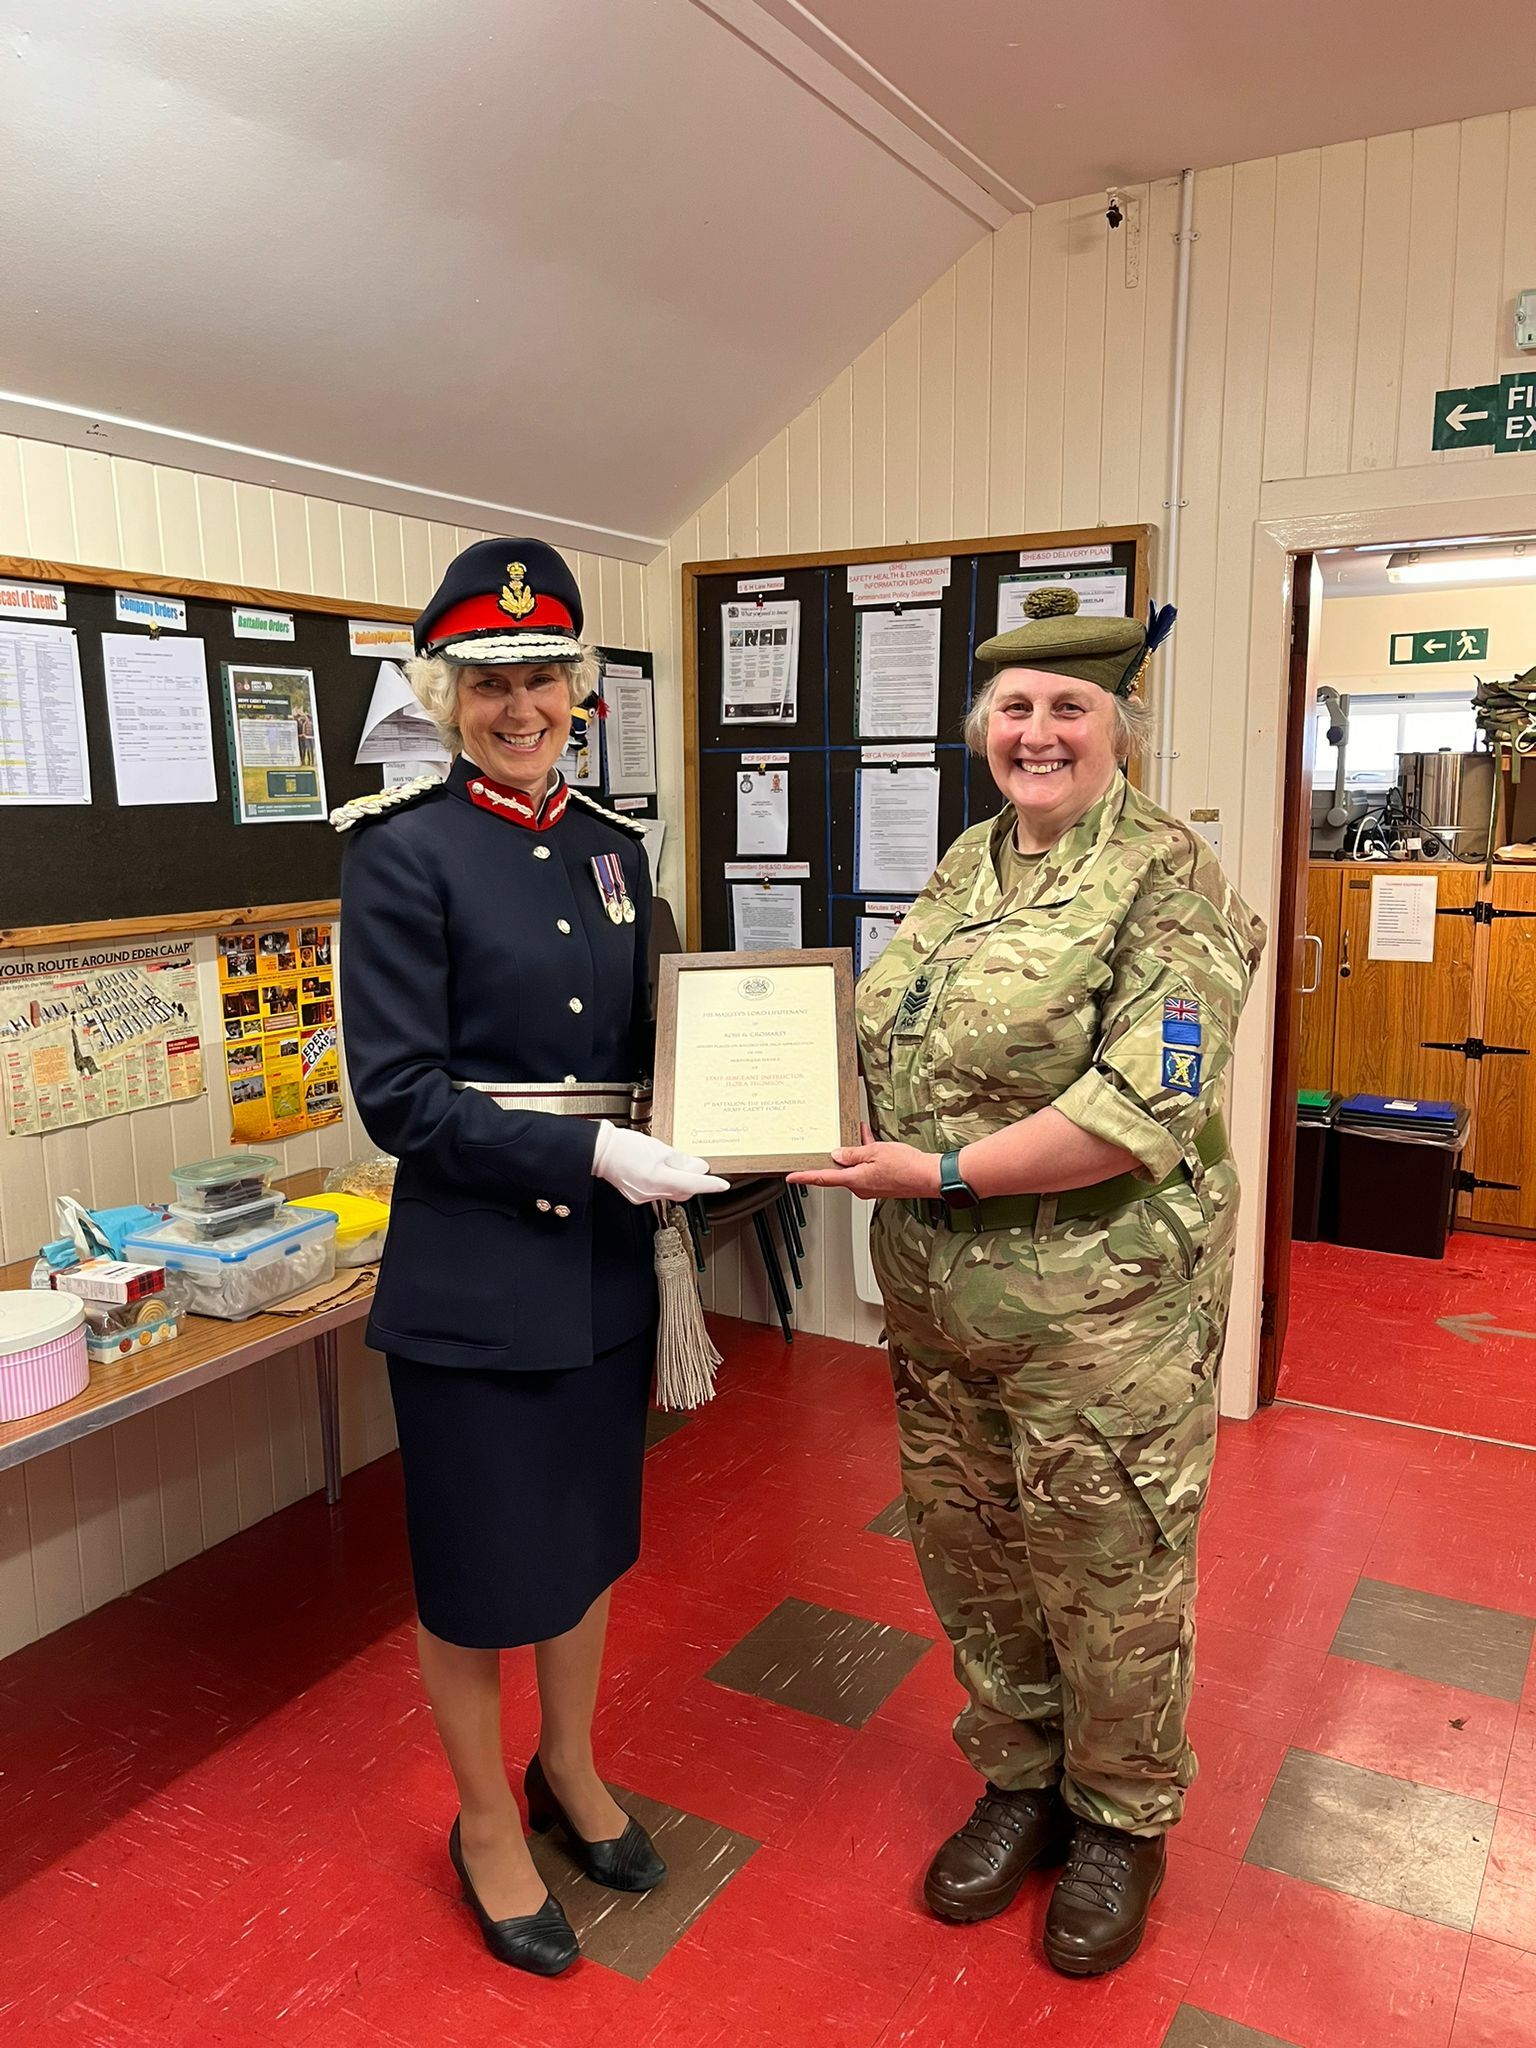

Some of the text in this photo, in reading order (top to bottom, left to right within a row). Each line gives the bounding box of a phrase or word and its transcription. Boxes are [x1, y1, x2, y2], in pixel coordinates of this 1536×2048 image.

[1507, 385, 1536, 410] FI
[1053, 549, 1088, 559] DELIVERY
[1090, 547, 1110, 556] PLAN
[849, 574, 872, 583] SAFETY
[873, 572, 899, 580] HEALTH
[864, 580, 908, 589] INFORMATION
[0, 590, 58, 611] cast of Events
[119, 594, 178, 620] Company Orders
[238, 615, 290, 633] Battalion Orders
[0, 963, 35, 976] YOUR
[37, 958, 79, 972] ROUTE
[81, 951, 130, 968] AROUND
[132, 946, 159, 960] EDEN
[901, 1017, 918, 1028] ACF
[303, 1028, 326, 1058] EDEN
[307, 1034, 330, 1065] CAMP
